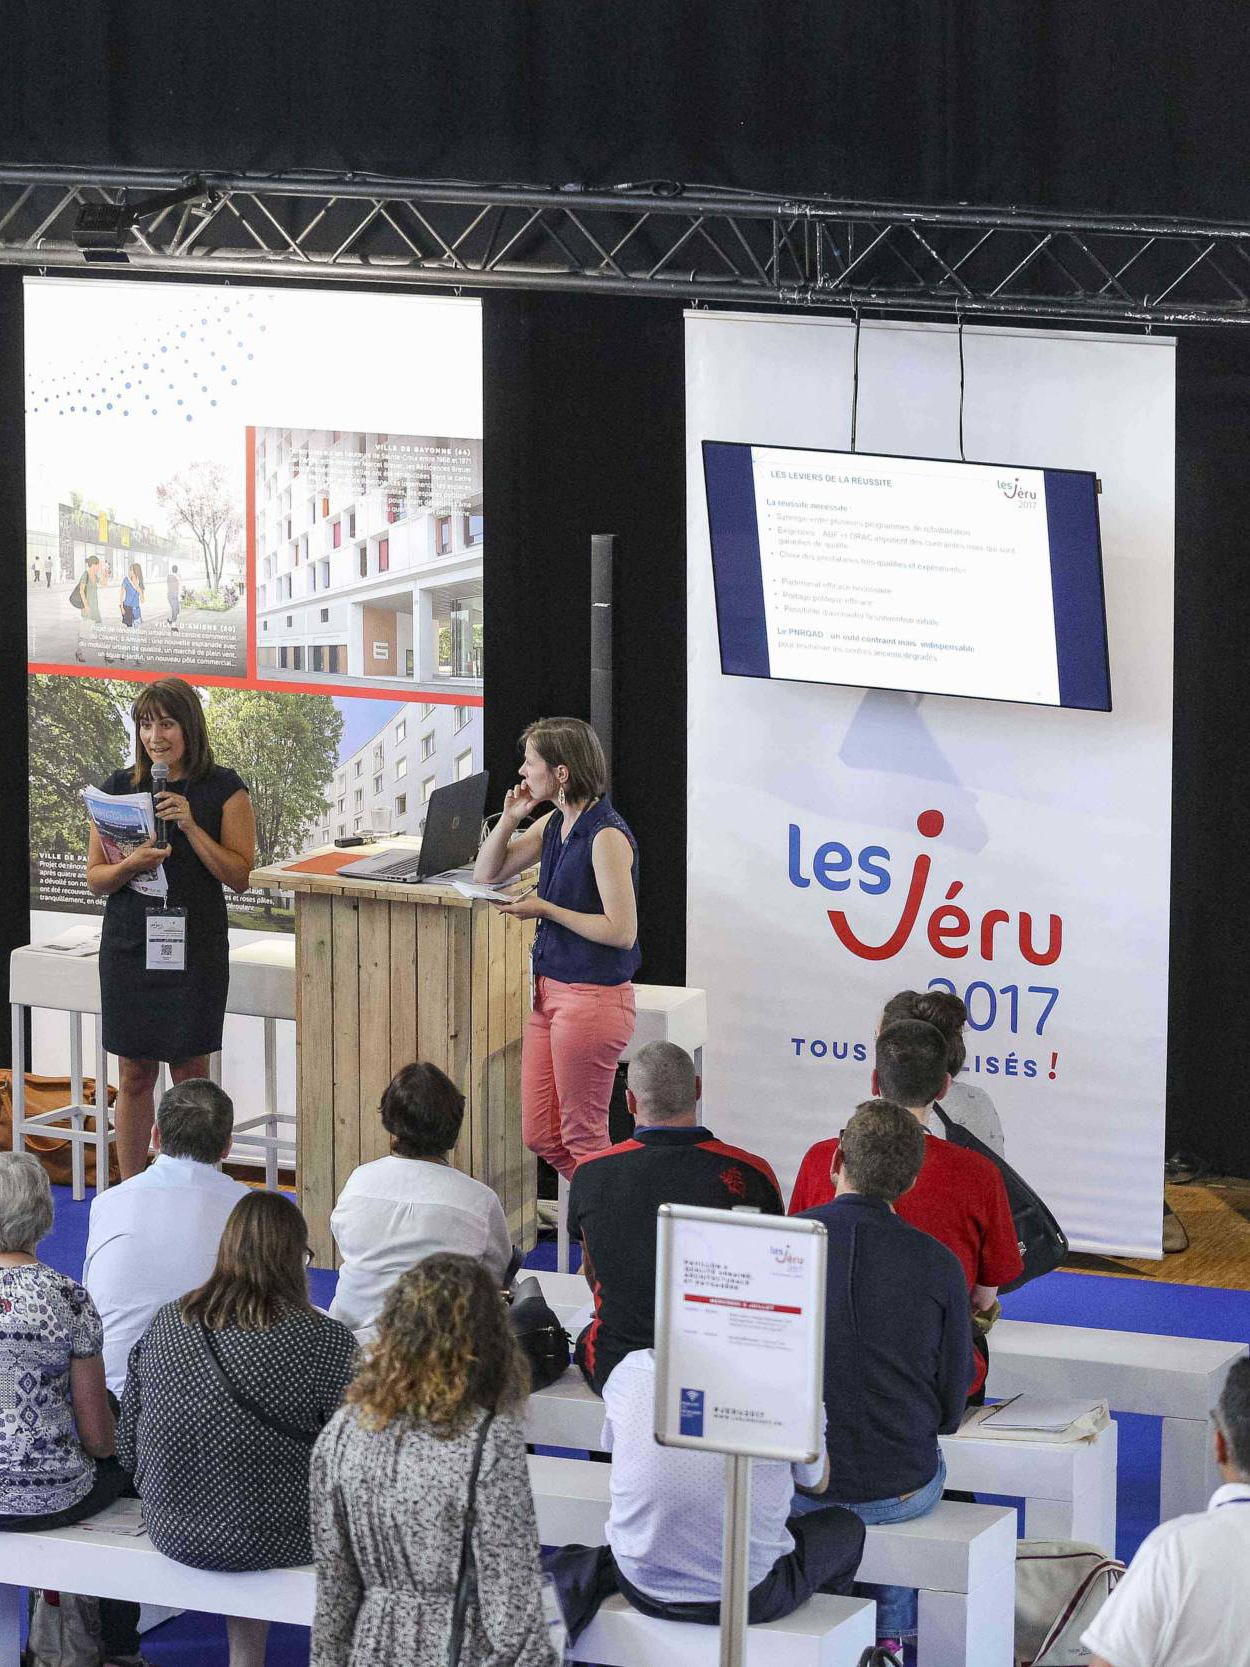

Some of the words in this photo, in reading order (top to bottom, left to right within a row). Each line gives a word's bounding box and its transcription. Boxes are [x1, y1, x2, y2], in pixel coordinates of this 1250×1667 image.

[375, 444, 397, 452] VILLE
[414, 446, 452, 455] BAYONNE
[455, 447, 471, 456] (64)
[770, 470, 787, 479] LES
[788, 472, 823, 482] LEVIERS
[825, 475, 836, 483] DE
[838, 476, 850, 484] LA
[996, 480, 1013, 490] les
[766, 498, 776, 506] La
[1018, 500, 1037, 509] 2017
[155, 620, 177, 628] VILLE
[179, 622, 217, 631] D'AMIENS
[172, 630, 181, 638] du
[777, 627, 787, 635] Le
[164, 638, 191, 647] nouvelle
[173, 648, 196, 656] marché
[205, 650, 221, 658] plein
[39, 852, 62, 860] VILLE
[788, 823, 892, 895] les
[39, 860, 58, 869] Projet
[57, 861, 67, 869] de
[66, 862, 88, 871] rénova
[39, 869, 56, 877] après
[56, 870, 76, 879] quatre
[44, 877, 67, 886] dévoilé
[50, 886, 61, 894] été
[39, 894, 86, 905] tranquillement,
[95, 897, 107, 907] dég
[791, 1038, 868, 1062] TOUS
[962, 1051, 1038, 1078] ISÉS
